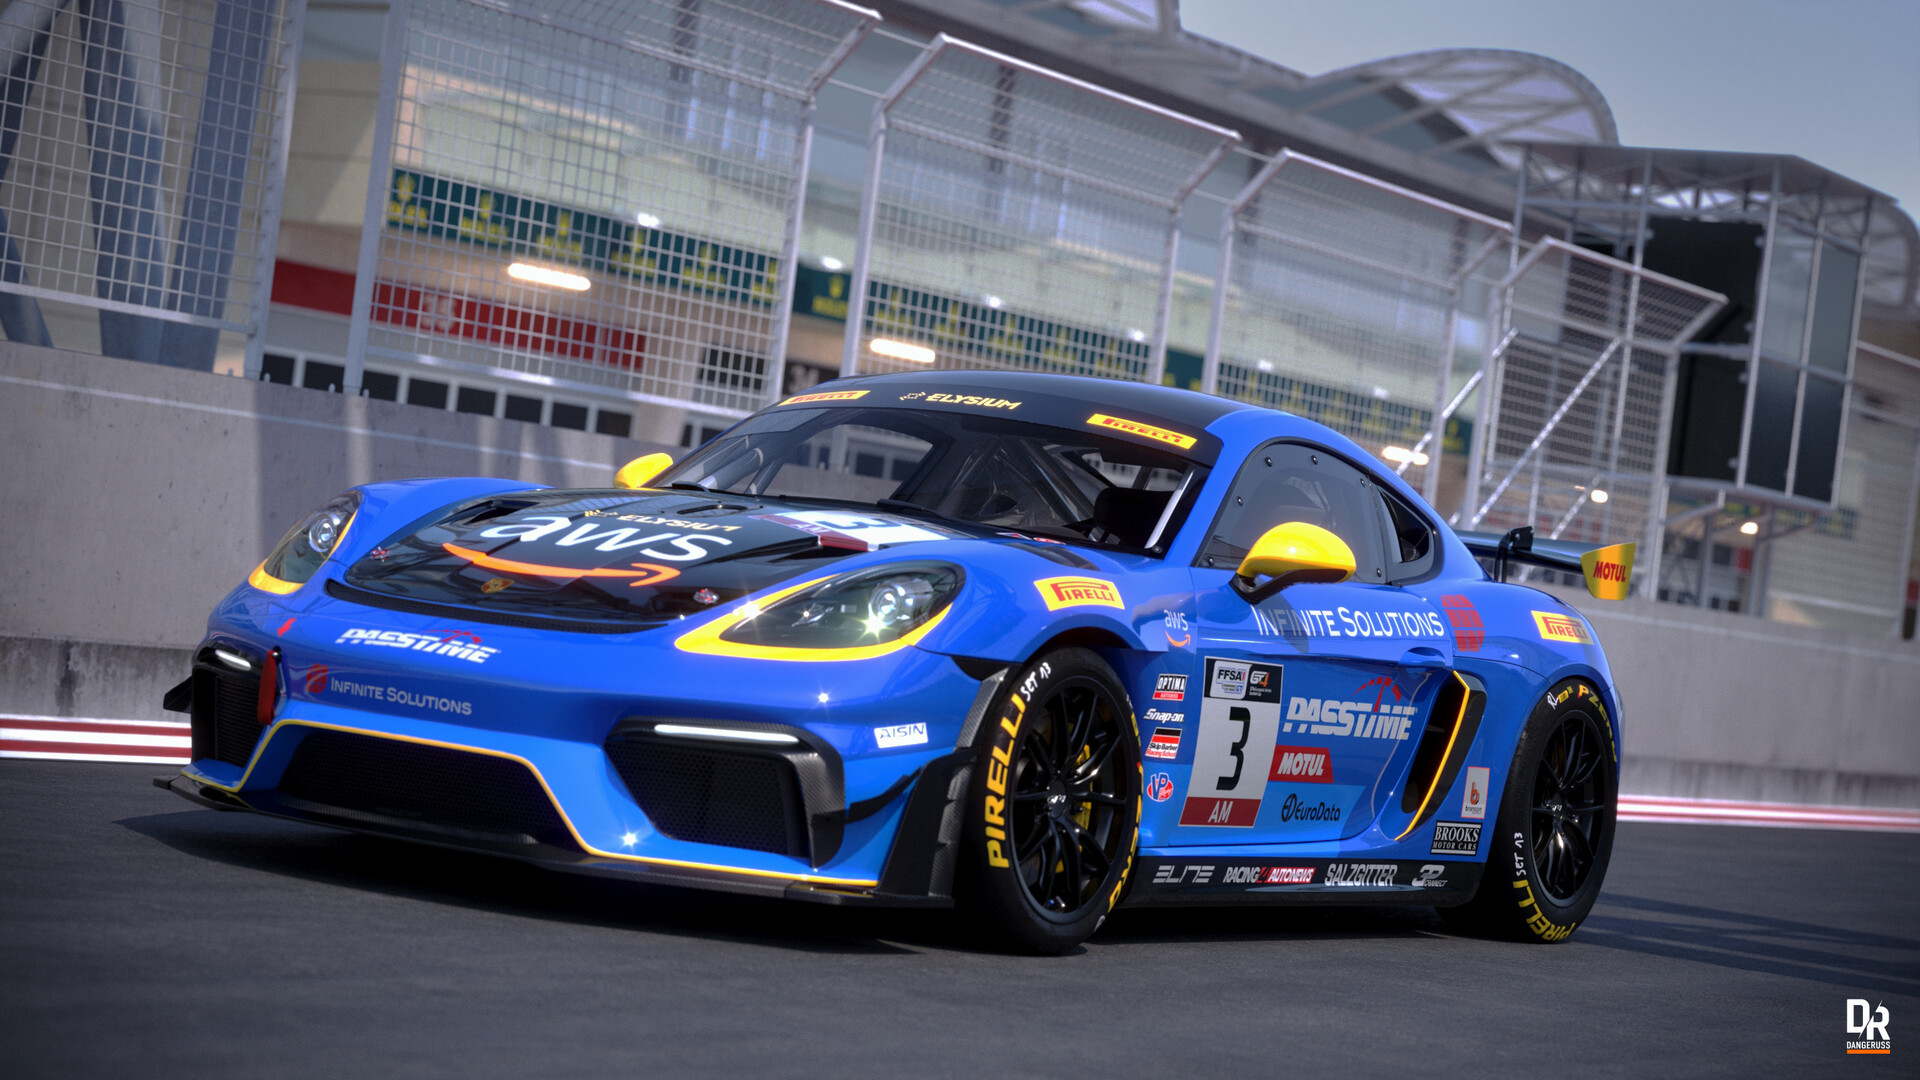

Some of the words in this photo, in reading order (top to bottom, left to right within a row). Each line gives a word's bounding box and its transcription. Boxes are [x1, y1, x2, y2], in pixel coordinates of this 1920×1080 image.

[926, 393, 1022, 410] ELYSIUM
[480, 516, 733, 561] aws
[1593, 560, 1627, 583] MOTUL
[1050, 581, 1115, 602] PIRELLI
[1163, 609, 1189, 631] aws
[1337, 606, 1445, 637] SOLUTIONS
[1541, 616, 1588, 640] PIRELLI
[1157, 676, 1185, 691] OPTIMA
[1217, 669, 1242, 681] FFSA
[1143, 708, 1185, 724] Snap-on
[1282, 696, 1416, 740] PASSTIME
[880, 724, 925, 739] AISIN
[1216, 706, 1251, 791] 3
[1277, 752, 1326, 777] MOTUL
[985, 693, 1027, 868] PIRELLI
[1151, 772, 1169, 801] VP
[1207, 800, 1234, 824] AM
[1295, 801, 1341, 822] EuroData
[1432, 841, 1456, 849] MOTOR
[1458, 842, 1477, 851] CARS
[1434, 826, 1480, 843] BROOKS
[1324, 863, 1398, 887] SALZGITTER
[1513, 879, 1576, 941] PIRELLI
